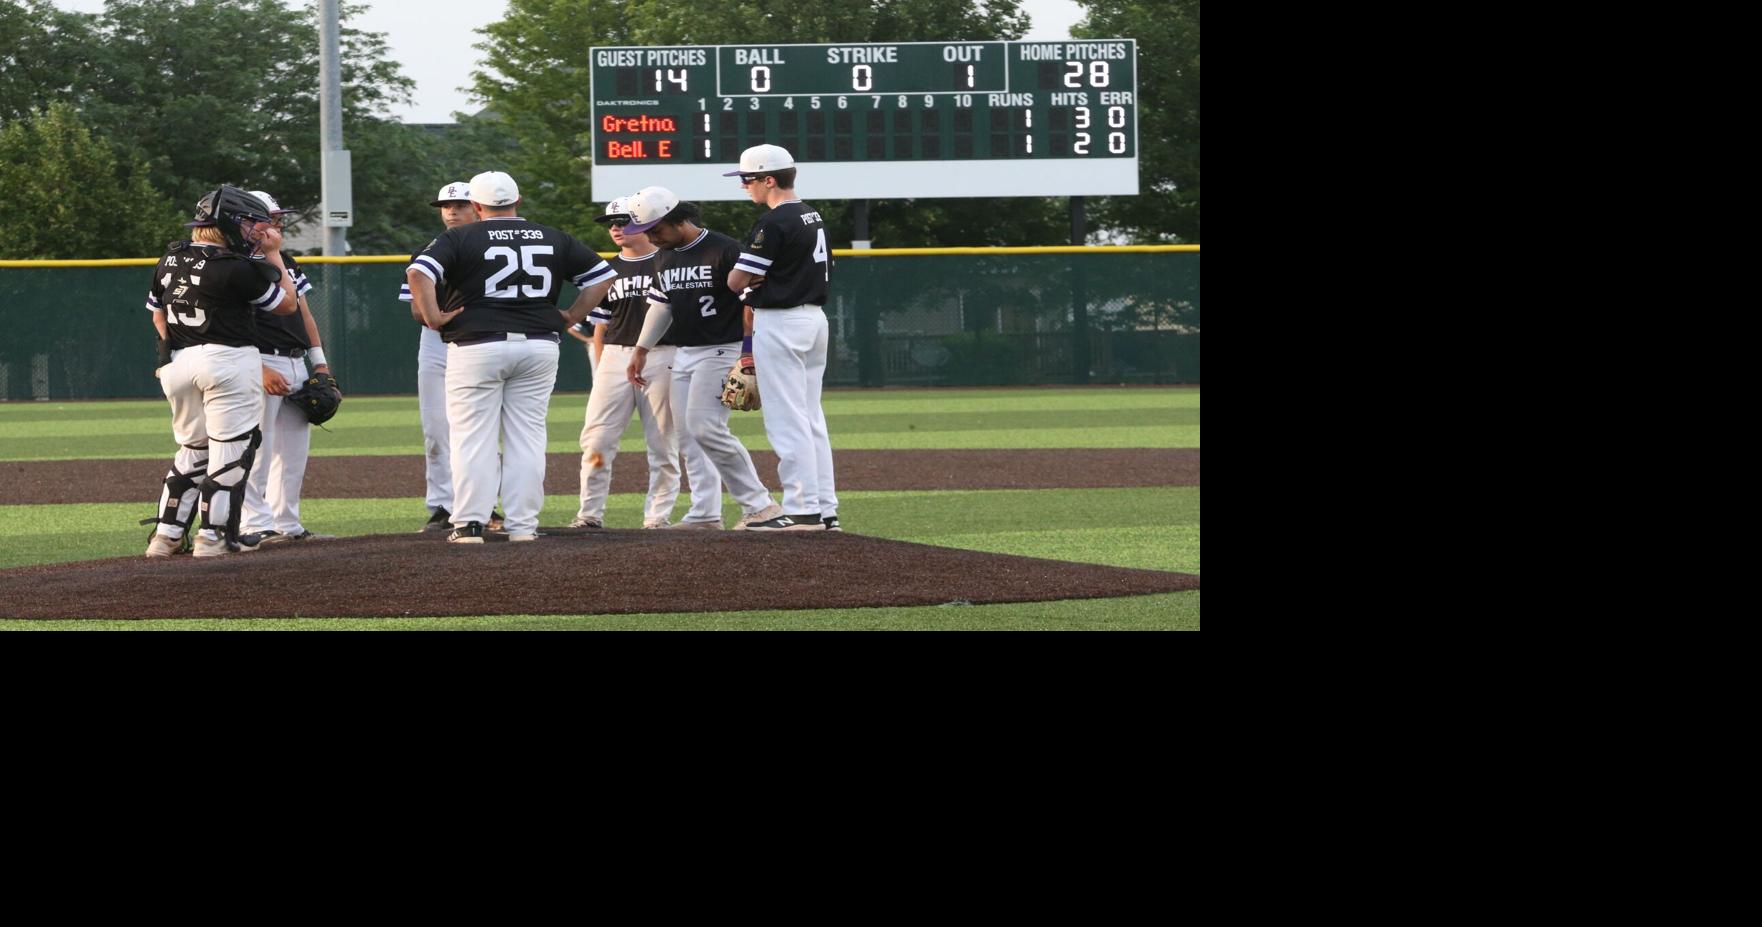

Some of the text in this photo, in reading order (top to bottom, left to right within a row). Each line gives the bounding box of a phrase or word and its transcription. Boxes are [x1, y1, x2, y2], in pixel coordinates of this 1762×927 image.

[597, 49, 706, 67] GUEST PITCHES
[735, 49, 786, 65] BALL
[827, 47, 898, 64] STRIKE
[943, 46, 984, 62] OUT
[1020, 43, 1126, 61] HOME PITCHES
[654, 69, 688, 92] 14
[750, 66, 770, 93] 0
[852, 65, 872, 91] 0
[967, 64, 974, 88] 1
[1064, 61, 1110, 88] 28
[698, 91, 1132, 111] 1 2 3 4 5 6 7 8 9 10 RUNS HITS ERR
[603, 106, 1126, 132] Gretna 1 1 3 0
[608, 131, 1126, 158] Bell. E 1 1 2 0
[813, 228, 829, 282] 4
[484, 245, 554, 299] 25
[699, 295, 717, 317] 2
